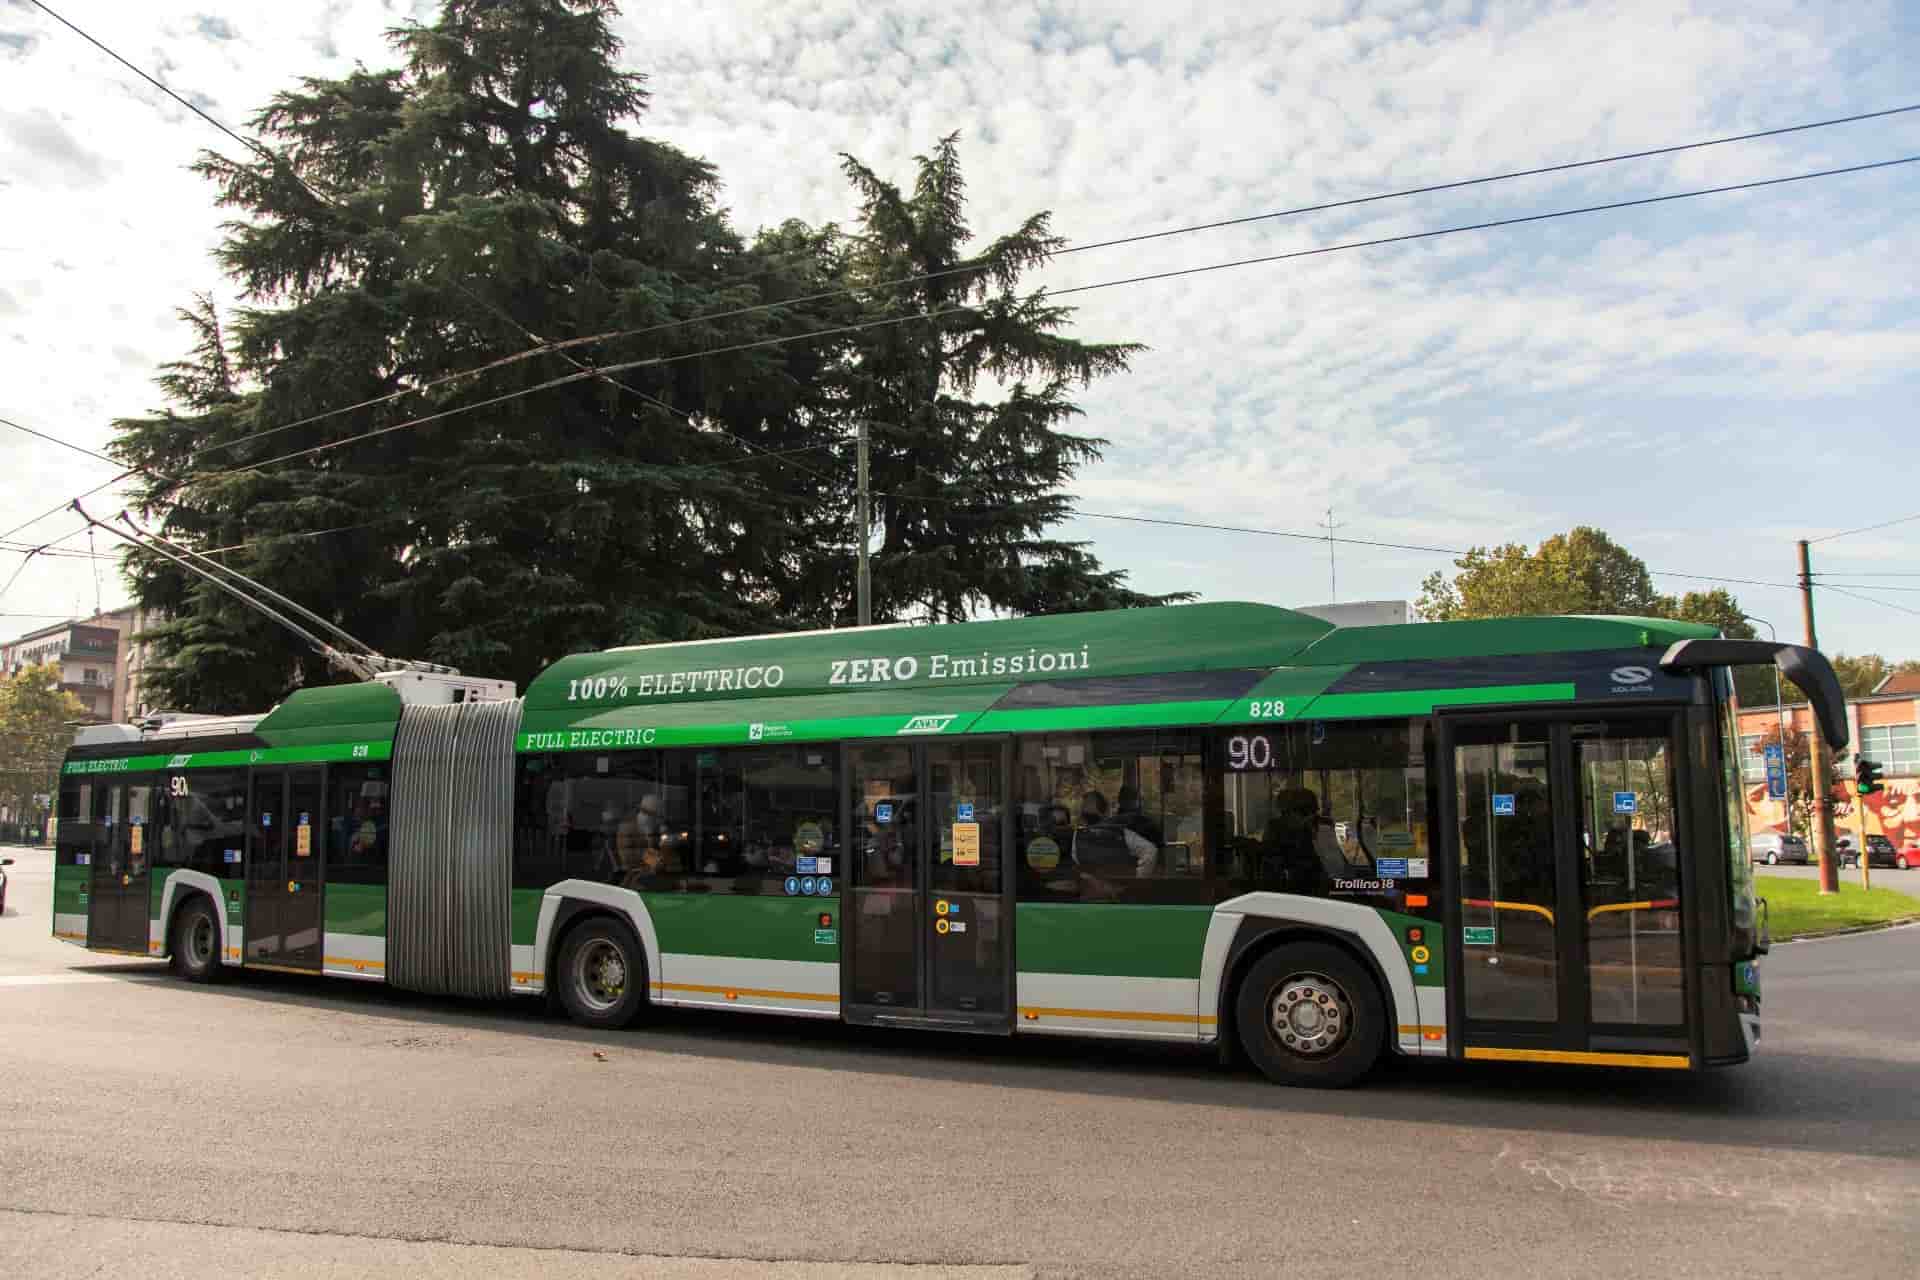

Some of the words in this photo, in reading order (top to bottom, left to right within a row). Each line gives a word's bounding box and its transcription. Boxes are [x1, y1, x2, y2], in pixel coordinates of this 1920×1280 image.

[567, 676, 628, 700] 100%
[637, 665, 784, 696] ELETTRICO
[829, 656, 918, 684] ZERO
[929, 644, 1089, 678] Emissioni
[1250, 700, 1285, 717] 828
[526, 731, 565, 750] FULL
[570, 729, 656, 748] ELECTRIC
[1335, 878, 1380, 889] Trollino
[1382, 878, 1395, 889] 18
